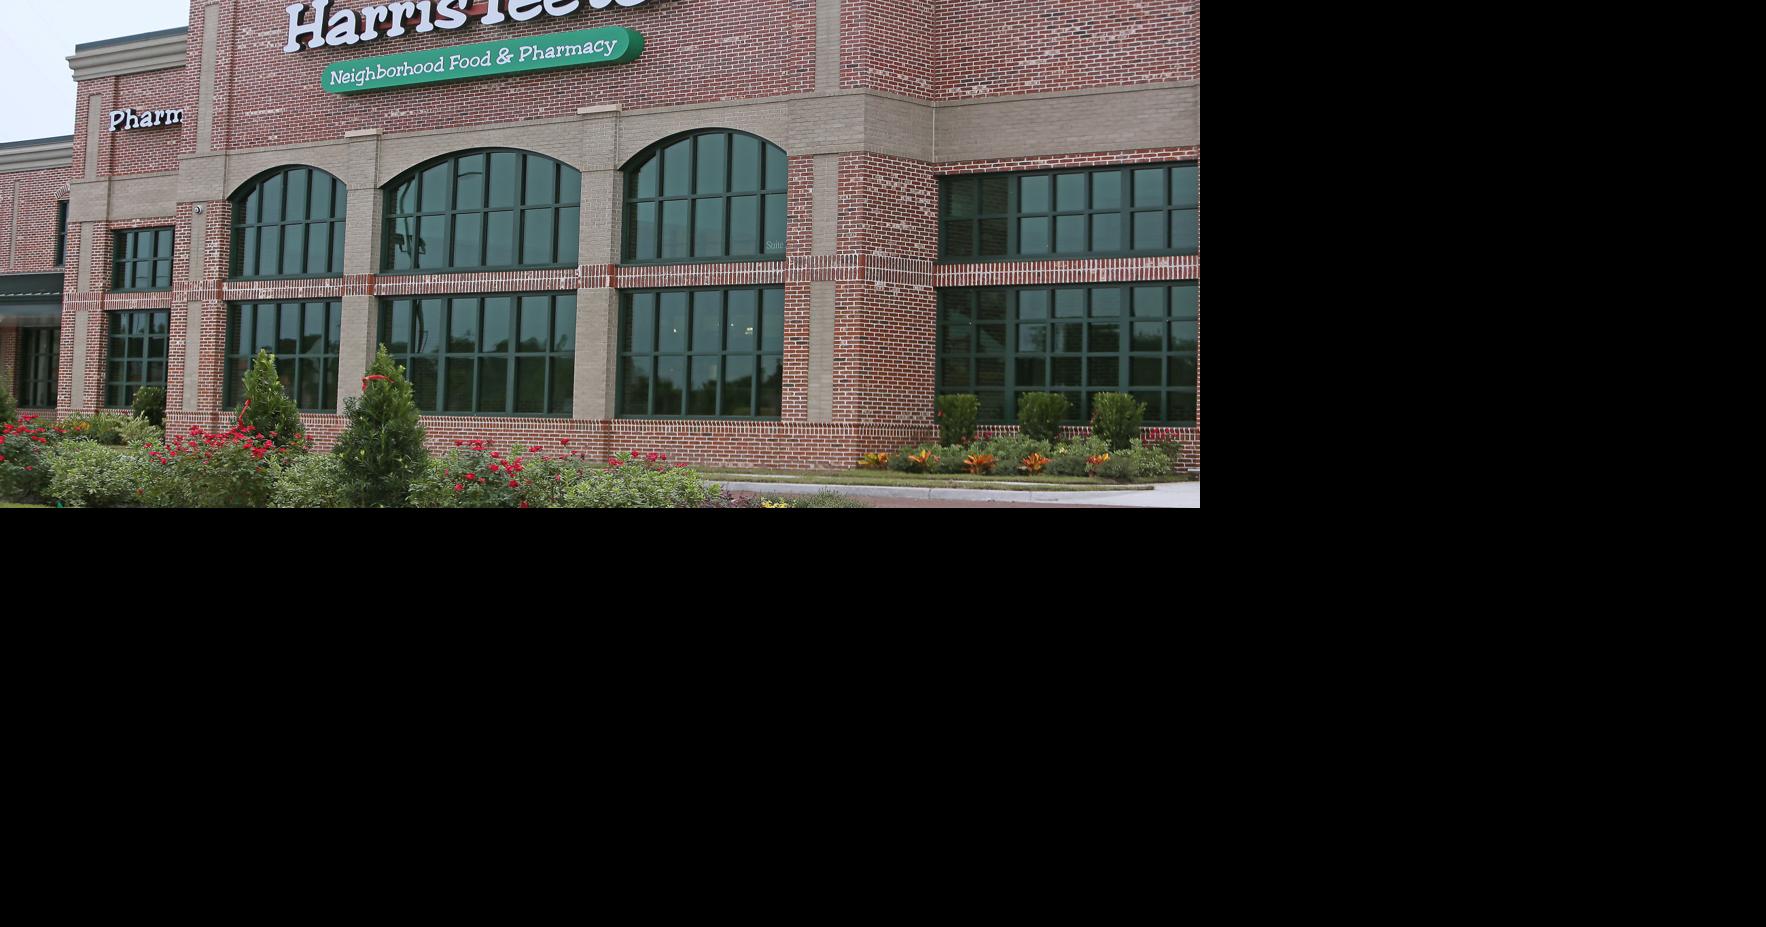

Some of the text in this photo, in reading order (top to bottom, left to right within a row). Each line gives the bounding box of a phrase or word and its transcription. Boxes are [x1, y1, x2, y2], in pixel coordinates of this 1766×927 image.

[283, 0, 467, 53] Harris
[330, 39, 618, 86] Neighborhood Food & Pharmacy
